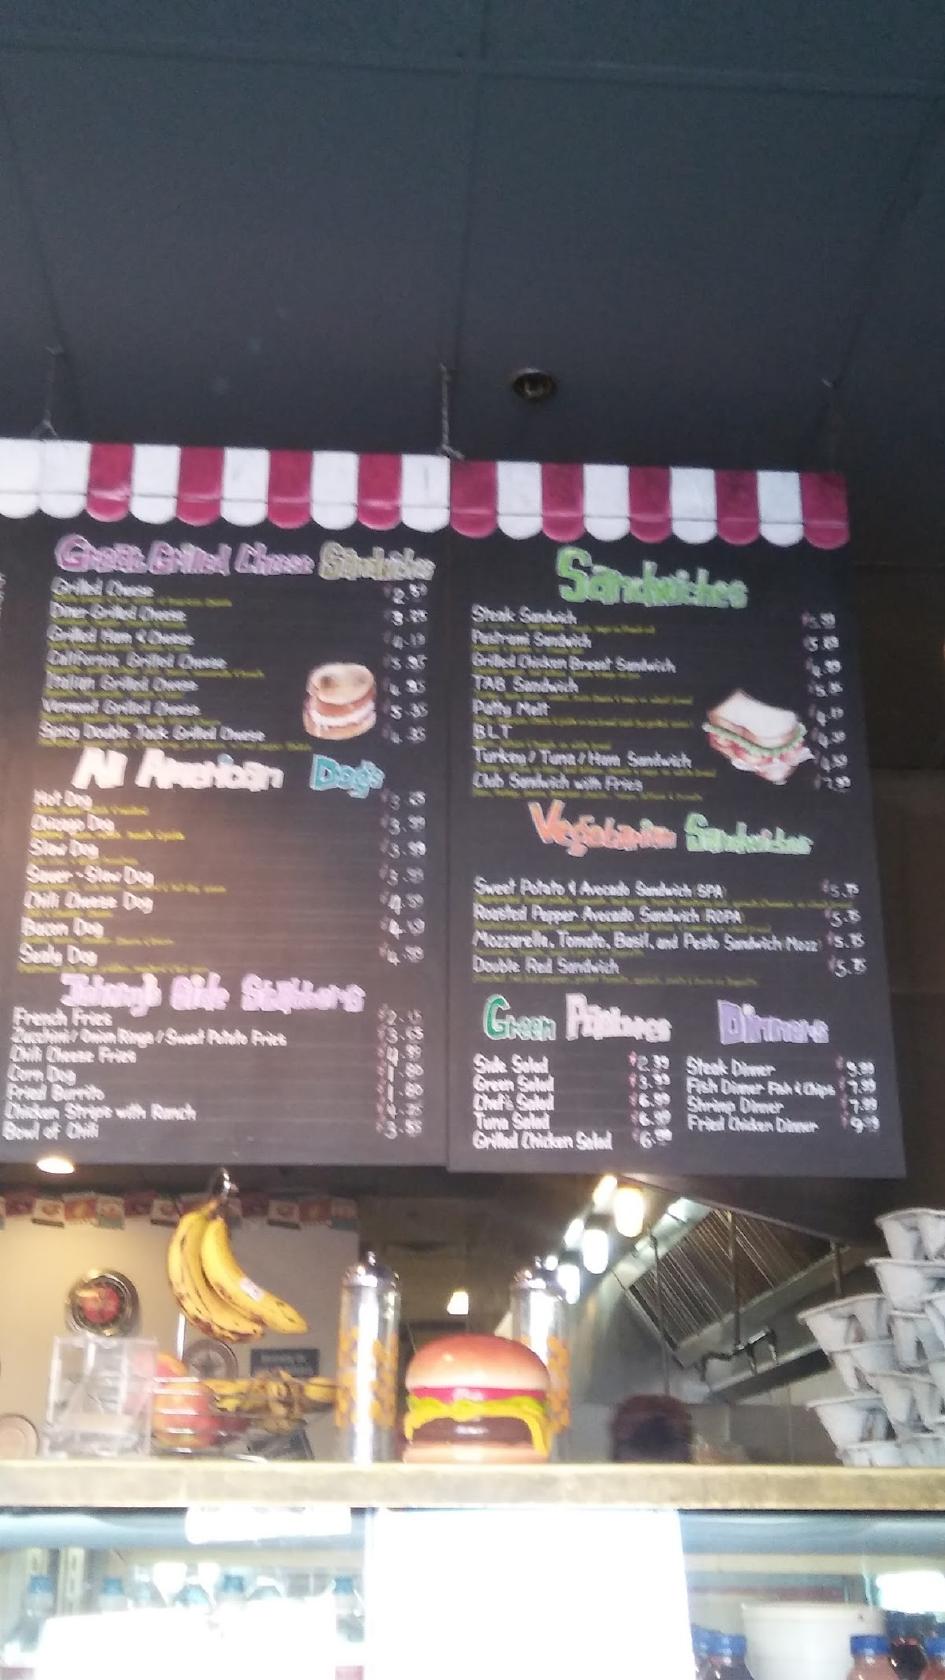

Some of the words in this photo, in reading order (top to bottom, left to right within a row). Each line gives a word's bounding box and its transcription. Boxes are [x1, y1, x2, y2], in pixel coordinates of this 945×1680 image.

[556, 546, 748, 608] Sandwiches
[472, 604, 515, 624] Steak
[518, 605, 577, 625] Sandwich
[533, 631, 592, 649] Sandwich
[615, 656, 676, 674] Sandwich
[513, 675, 579, 694] Sandwich
[472, 746, 526, 766] Turkey
[538, 749, 576, 766] Tuna
[588, 751, 620, 767] Ham
[627, 750, 692, 769] Sandwich
[71, 747, 128, 789] All
[135, 747, 286, 792] American
[472, 771, 504, 789] Club
[509, 772, 569, 790] Sandwich
[574, 774, 601, 791] with
[605, 775, 643, 792] Fries
[64, 790, 92, 811] Dog
[87, 813, 115, 832] Dog
[69, 839, 99, 859] Dog
[123, 865, 155, 887] Dog
[474, 875, 517, 895] Sweet
[520, 877, 565, 896] Potato
[635, 879, 692, 898] Sandwich
[122, 891, 154, 914] Dog
[639, 905, 699, 923] Sandwich
[73, 916, 104, 938] Dog
[656, 933, 679, 951] and
[723, 932, 782, 952] Sandwich
[67, 944, 98, 967] Dog
[557, 957, 620, 976] Sandwich
[12, 1006, 67, 1026] French
[71, 1007, 113, 1027] Fries
[483, 993, 557, 1041] Green
[717, 999, 830, 1046] Dinners
[165, 1027, 205, 1045] Sweet
[251, 1028, 287, 1046] Fries
[45, 1045, 95, 1063] Cheese
[98, 1045, 137, 1064] Fries
[511, 1053, 549, 1074] Salad
[7, 1063, 44, 1082] Corn
[46, 1065, 77, 1086] Dog
[686, 1056, 728, 1076] Steak
[732, 1058, 776, 1077] Dinner
[5, 1082, 47, 1101] Fried
[472, 1073, 515, 1092] Green
[516, 1074, 555, 1093] Salad
[686, 1076, 718, 1095] Fish
[721, 1078, 765, 1096] Dinner
[4, 1101, 60, 1120] Chicken
[114, 1102, 147, 1121] with
[150, 1103, 197, 1121] Ranch
[516, 1092, 555, 1111] Salad
[687, 1095, 736, 1115] Shrimp
[740, 1096, 784, 1115] Dinner
[42, 1121, 62, 1140] of
[473, 1111, 509, 1130] Tuna
[511, 1111, 550, 1130] Salad
[688, 1114, 725, 1132] Fried
[728, 1115, 774, 1133] Chicken
[775, 1116, 820, 1134] Dinner
[472, 1130, 519, 1150] Grilled
[521, 1130, 574, 1150] Chicken
[575, 1131, 613, 1151] Salad
